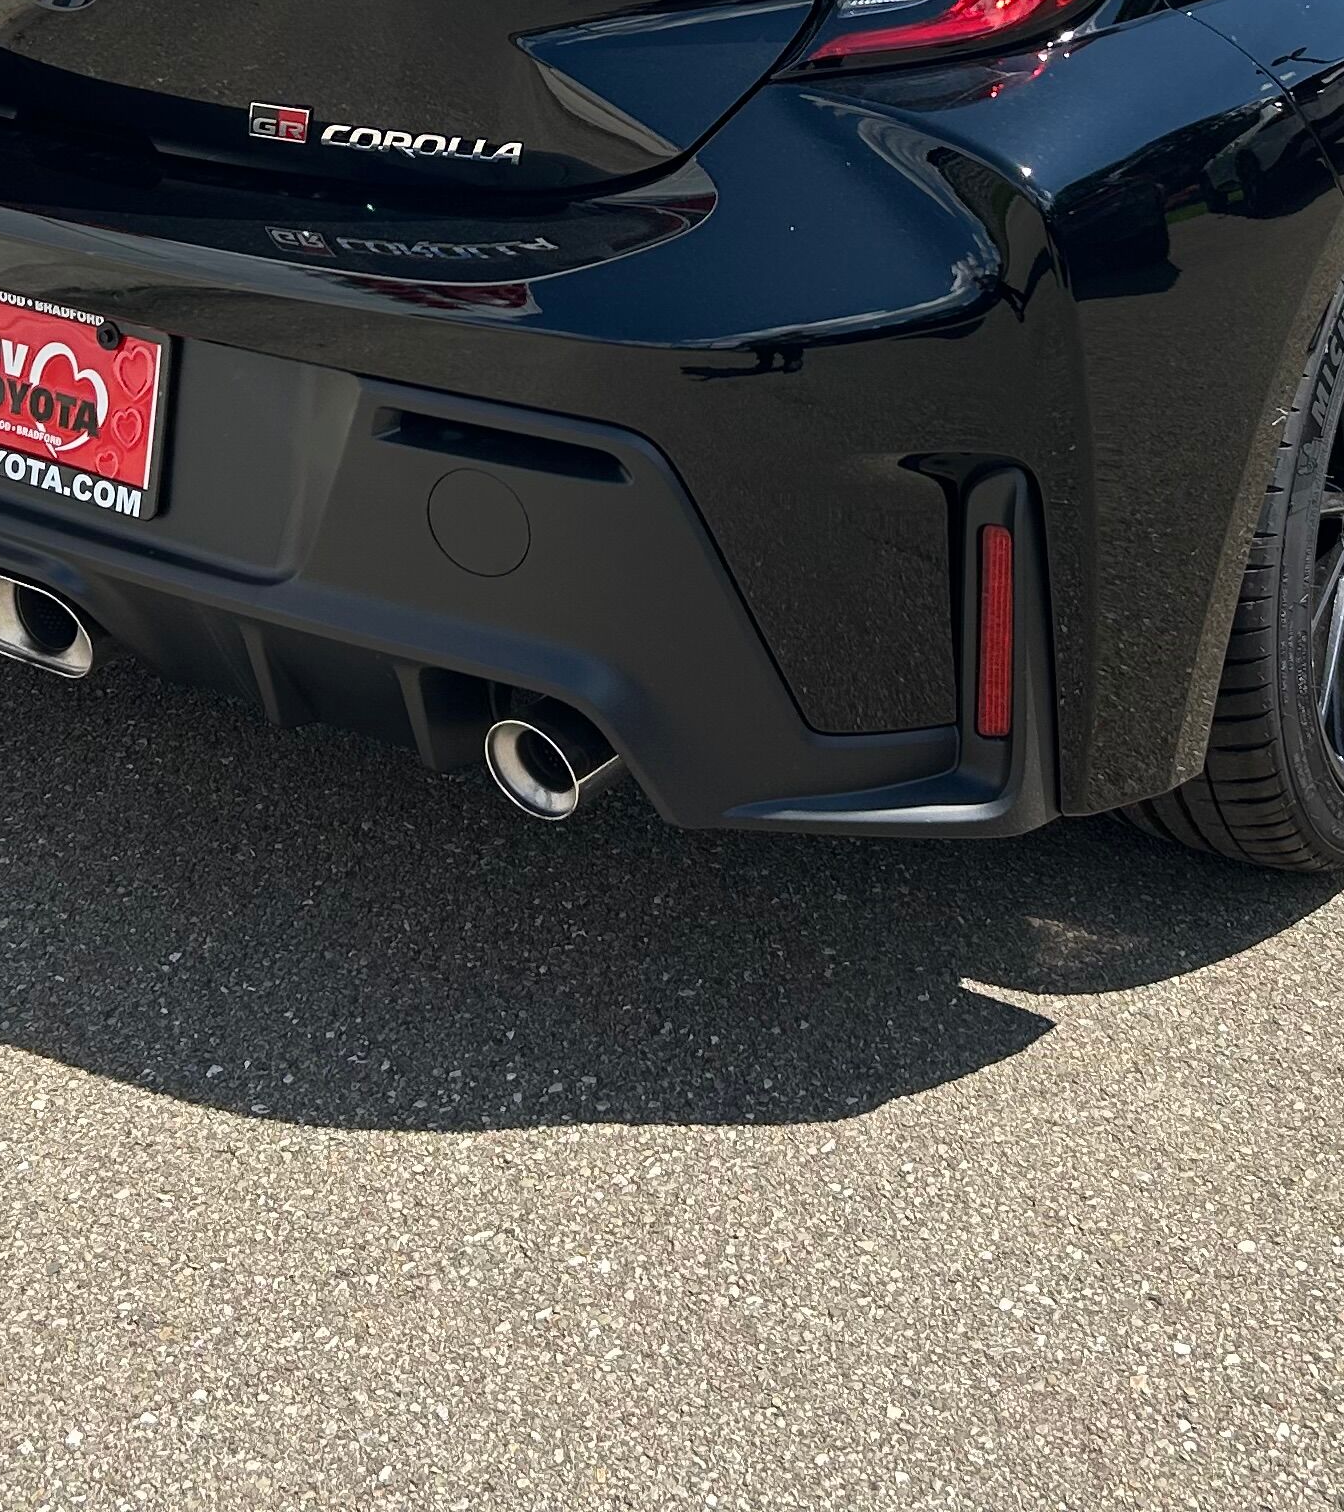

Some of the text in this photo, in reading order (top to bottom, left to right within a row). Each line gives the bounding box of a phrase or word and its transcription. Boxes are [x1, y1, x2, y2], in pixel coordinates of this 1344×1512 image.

[321, 124, 524, 166] COROLLA
[34, 300, 105, 326] BRADFORD
[16, 423, 63, 447] BRADFORD
